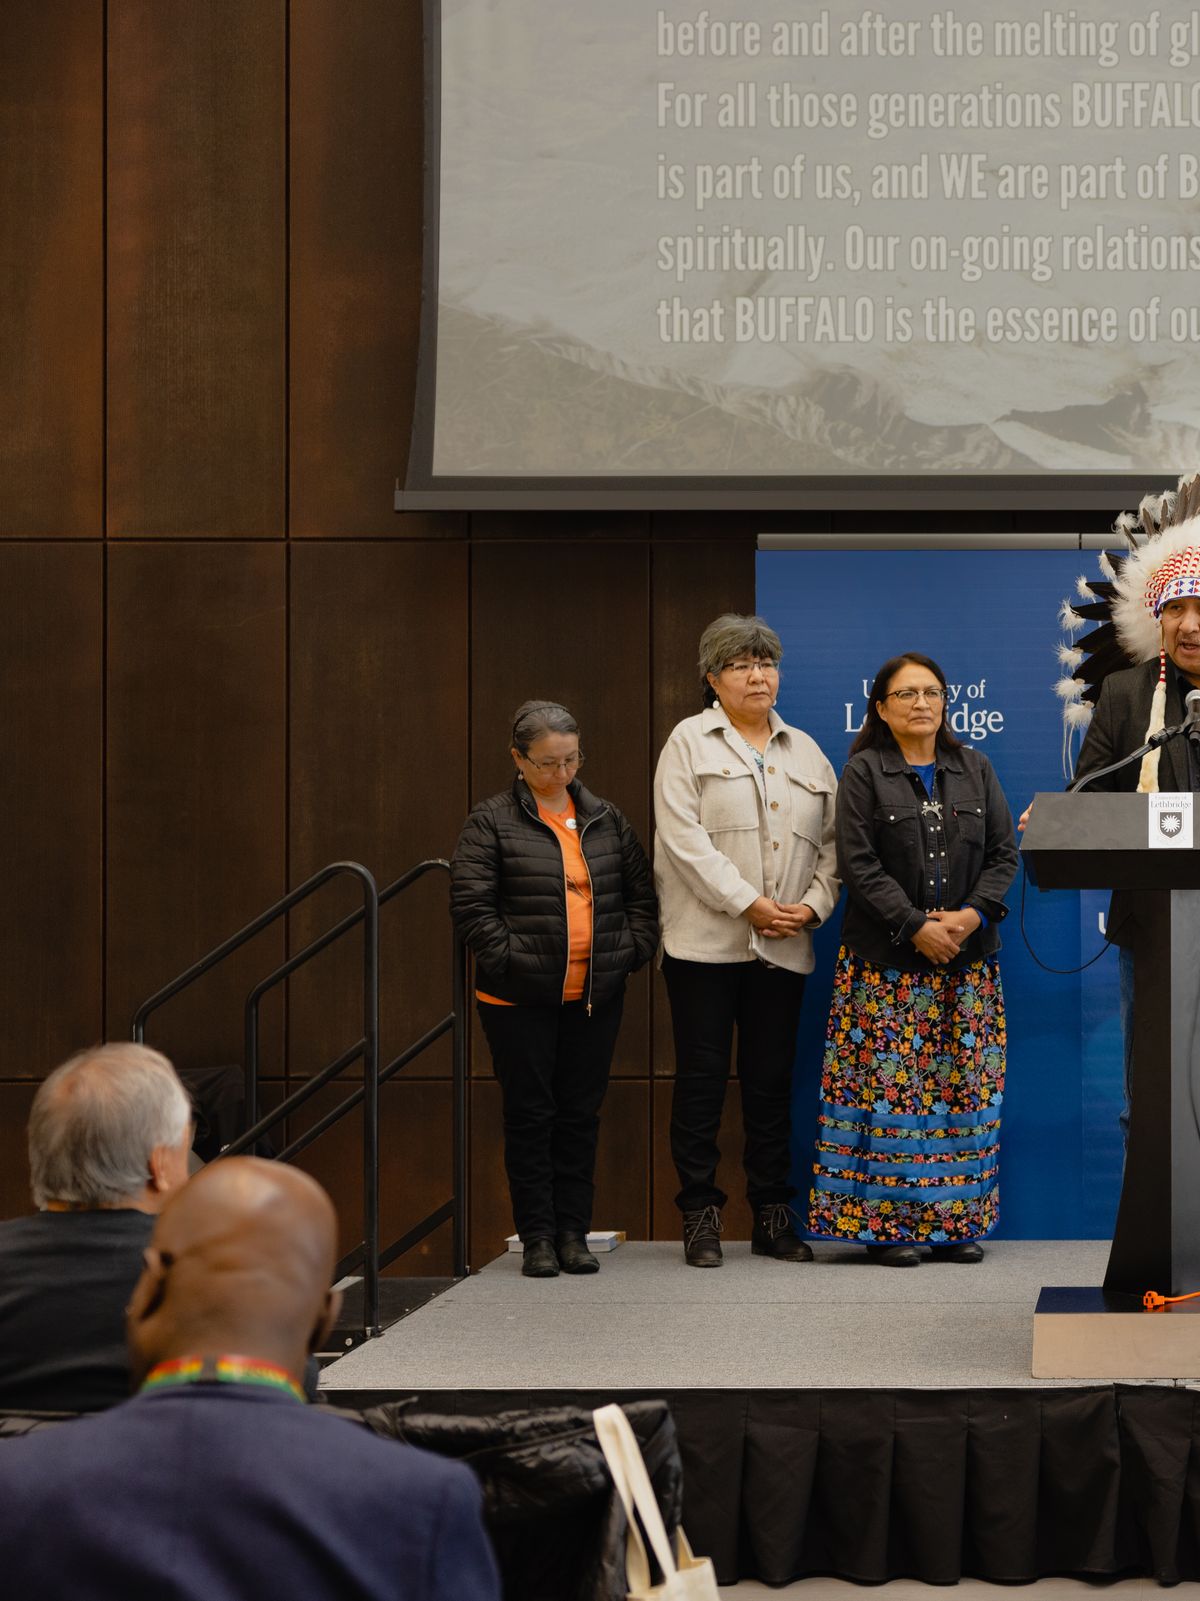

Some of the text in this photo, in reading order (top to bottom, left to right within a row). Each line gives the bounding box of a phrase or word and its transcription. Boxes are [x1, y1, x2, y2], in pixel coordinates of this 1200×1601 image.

[657, 10, 761, 56] before
[772, 11, 829, 56] and
[840, 10, 921, 57] after
[930, 11, 983, 56] the
[995, 11, 1119, 67] melting
[1129, 10, 1160, 56] of
[658, 82, 708, 128] For
[718, 82, 756, 127] all
[767, 82, 857, 128] those
[867, 82, 1061, 139] generations
[658, 154, 684, 199] is
[696, 157, 763, 210] part
[773, 153, 805, 199] of
[816, 164, 861, 207] us,
[871, 154, 928, 199] and
[939, 154, 987, 199] WE
[998, 164, 1049, 199] are
[1060, 157, 1126, 210] part
[1137, 153, 1169, 199] of
[657, 225, 834, 282] spiritually.
[845, 225, 900, 270] Our
[910, 225, 1053, 282] on-going
[656, 297, 725, 342] that
[735, 296, 874, 342] BUFFALO
[886, 296, 913, 342] is
[922, 297, 975, 342] the
[987, 307, 1117, 342] essence
[1129, 296, 1161, 342] of
[966, 679, 986, 699] of
